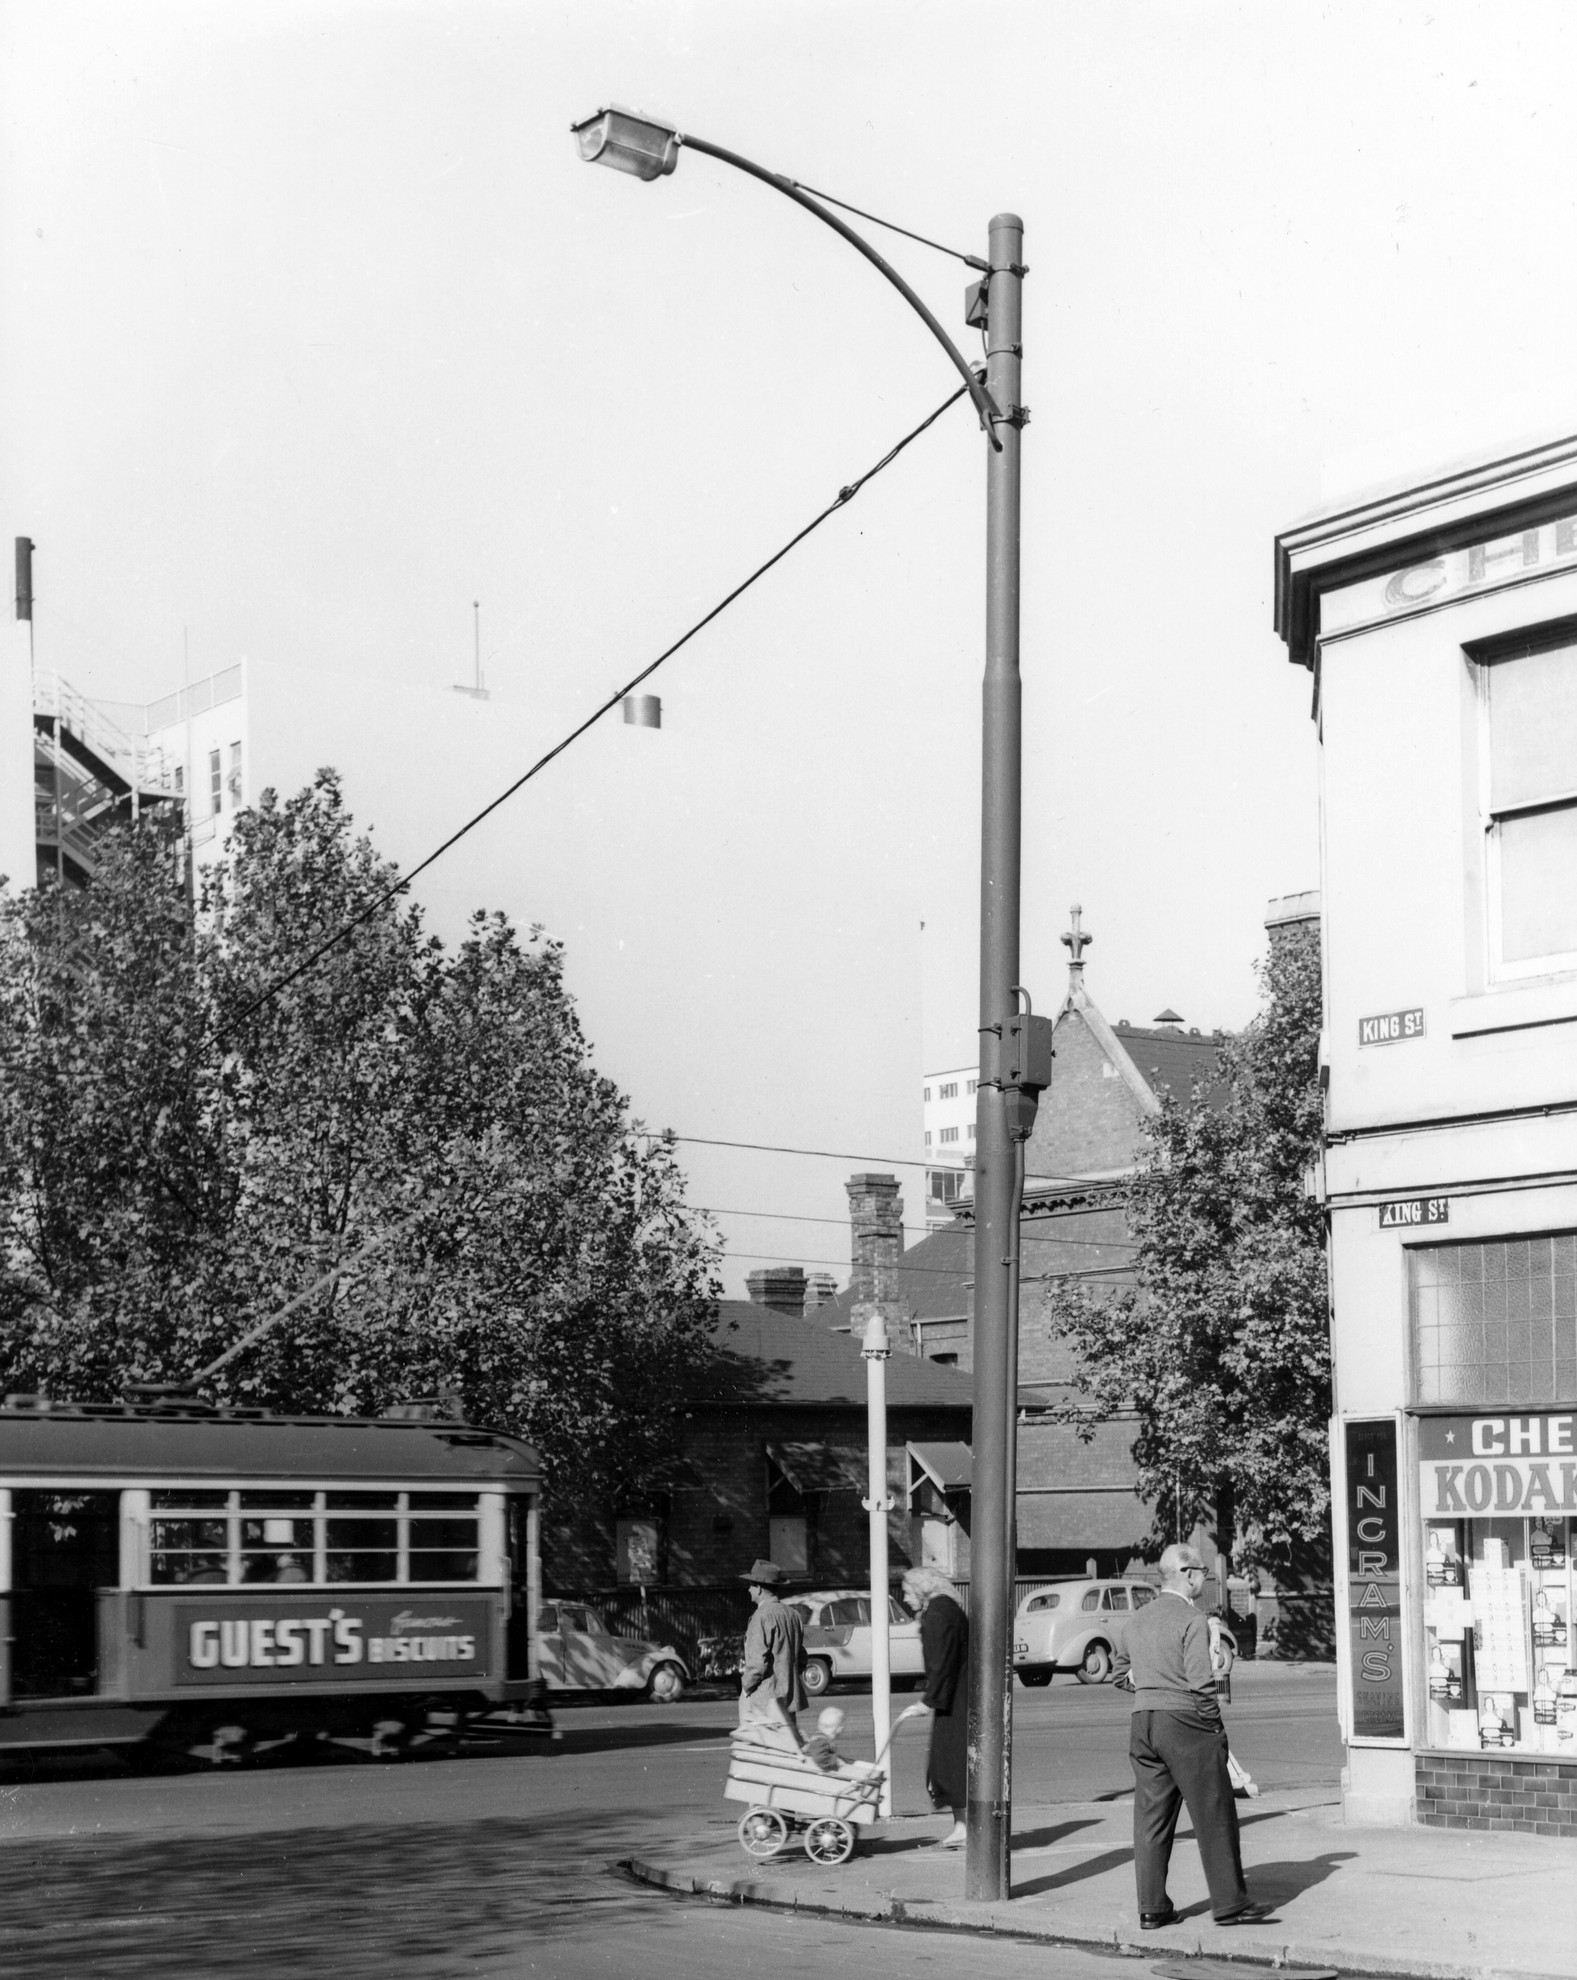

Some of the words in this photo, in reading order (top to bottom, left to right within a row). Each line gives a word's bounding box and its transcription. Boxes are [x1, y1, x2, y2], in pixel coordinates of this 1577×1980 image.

[1363, 1016, 1400, 1042] KING
[1382, 1201, 1422, 1226] KING
[1471, 1416, 1574, 1456] CHE
[190, 1608, 363, 1668] GUEST'S
[367, 1635, 475, 1663] BISCUITS
